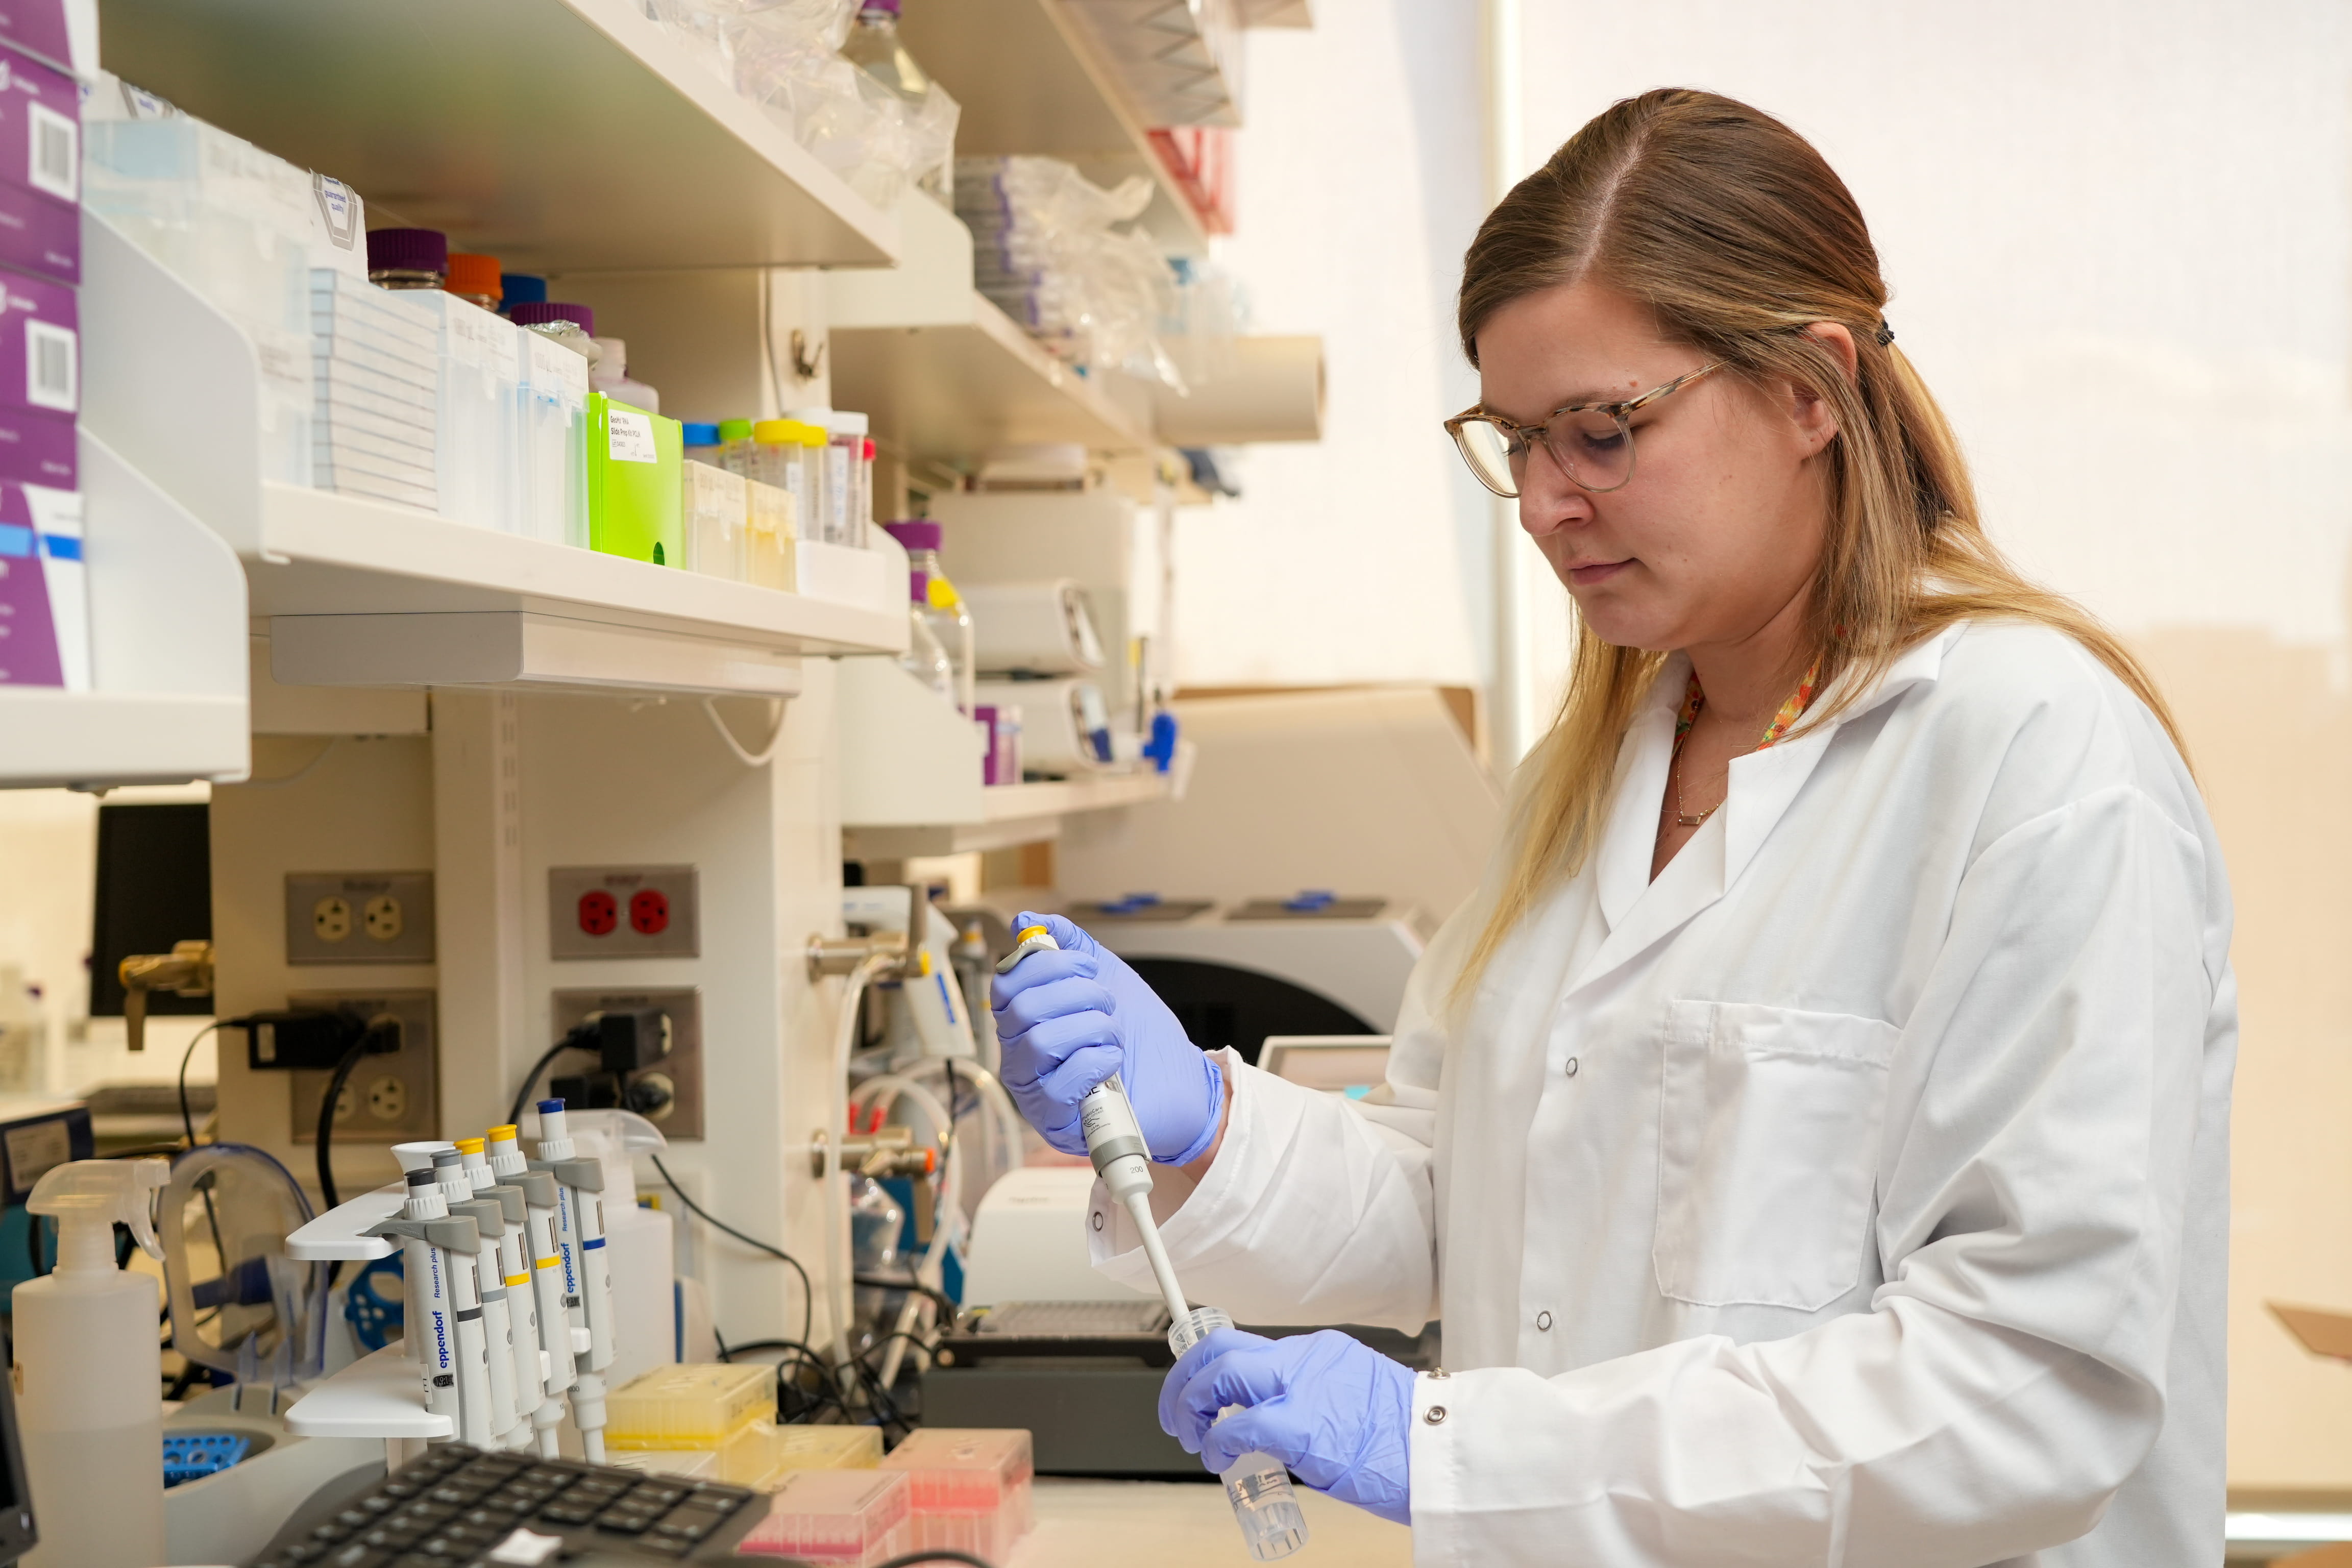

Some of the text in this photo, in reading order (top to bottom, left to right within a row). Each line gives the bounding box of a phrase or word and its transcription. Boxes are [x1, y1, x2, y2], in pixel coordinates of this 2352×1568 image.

[430, 1247, 440, 1298] Research plus
[560, 1242, 576, 1293] eppendorf
[432, 1311, 450, 1368] eppendorf
